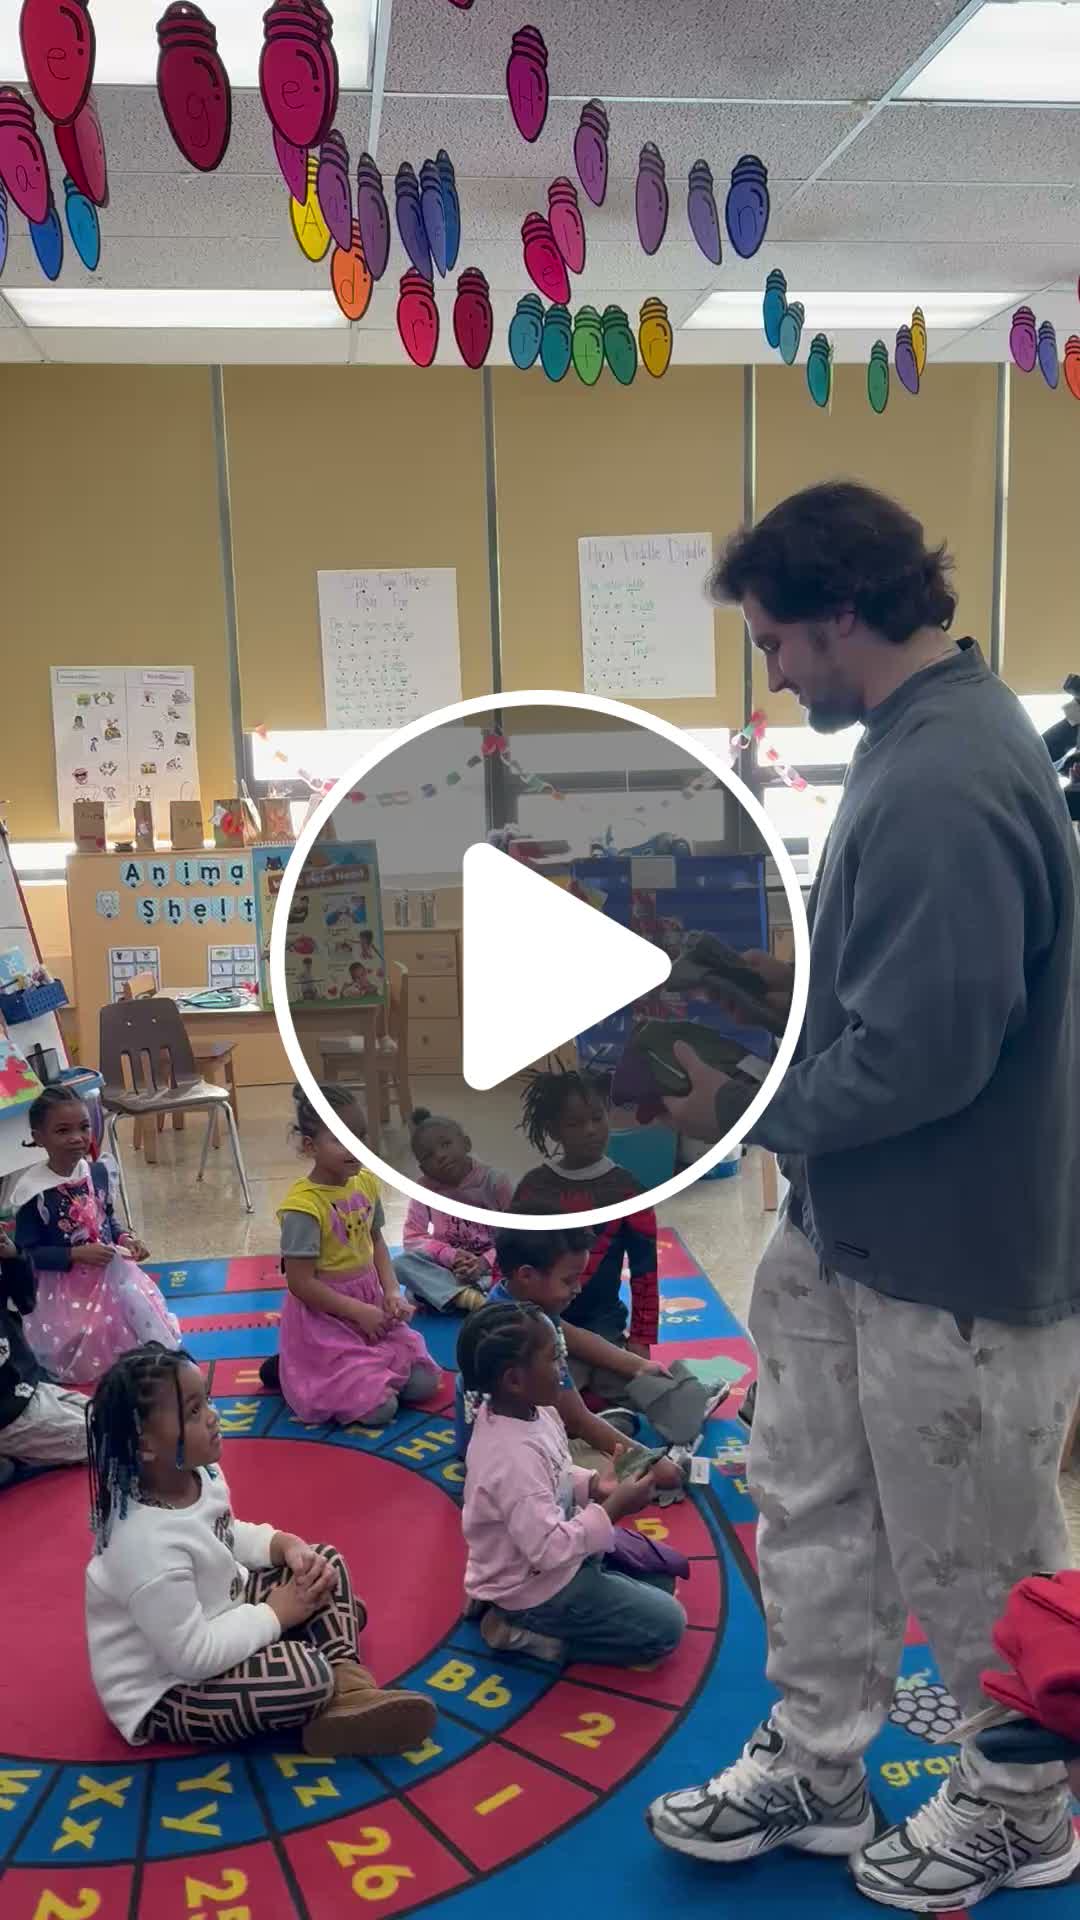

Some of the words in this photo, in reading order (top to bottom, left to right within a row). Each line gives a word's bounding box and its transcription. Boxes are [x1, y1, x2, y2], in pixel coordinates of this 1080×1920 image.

[301, 202, 324, 238] A
[125, 862, 244, 881] Anima
[143, 897, 254, 918] Shelt
[219, 1401, 262, 1432] Kk
[395, 1429, 456, 1461] Hh
[634, 1518, 669, 1541] 5
[425, 1659, 512, 1708] Bb
[560, 1712, 616, 1749] 2
[52, 1775, 134, 1852] Xx
[160, 1762, 233, 1838] Yy
[327, 1826, 416, 1901] 26
[184, 1868, 250, 1920] 2
